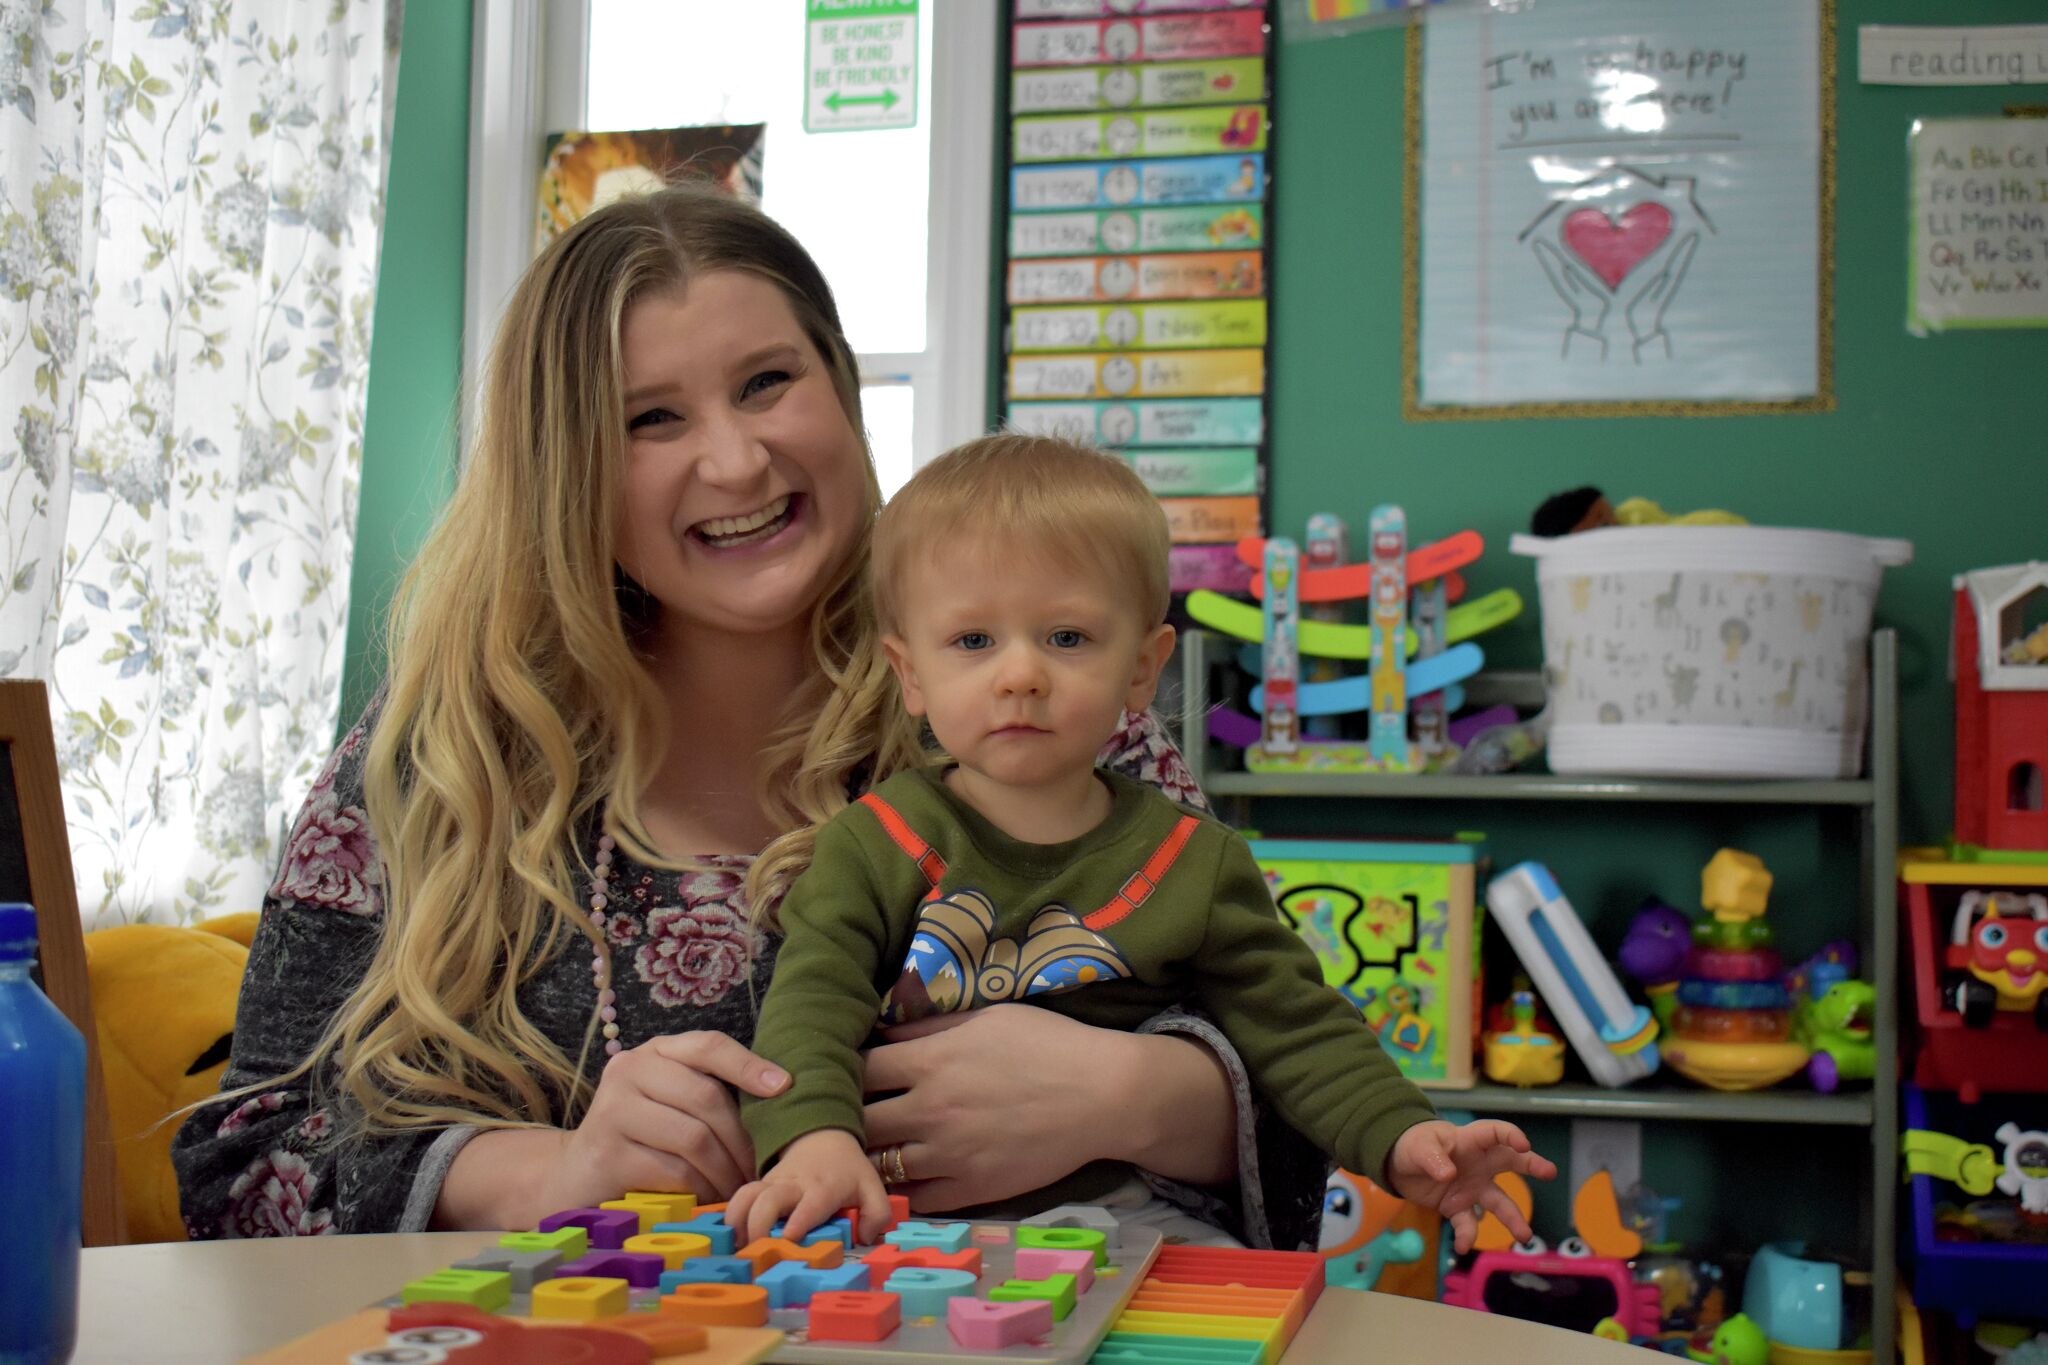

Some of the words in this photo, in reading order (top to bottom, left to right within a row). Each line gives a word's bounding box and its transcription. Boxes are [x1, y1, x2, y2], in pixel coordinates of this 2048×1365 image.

[821, 25, 838, 44] BE
[843, 22, 905, 42] HONEST
[832, 46, 848, 65] BE
[854, 44, 893, 62] KIND
[1483, 50, 1557, 91] I'm
[1635, 39, 1747, 82] happy
[1889, 37, 2025, 85] reading
[814, 68, 831, 88] BE
[836, 65, 911, 86] FRIENDLY
[1509, 99, 1559, 142] you
[1930, 146, 1965, 170] Aa
[1969, 144, 2002, 170] Bb
[1999, 178, 2032, 204] Hh
[2007, 211, 2045, 232] Nn
